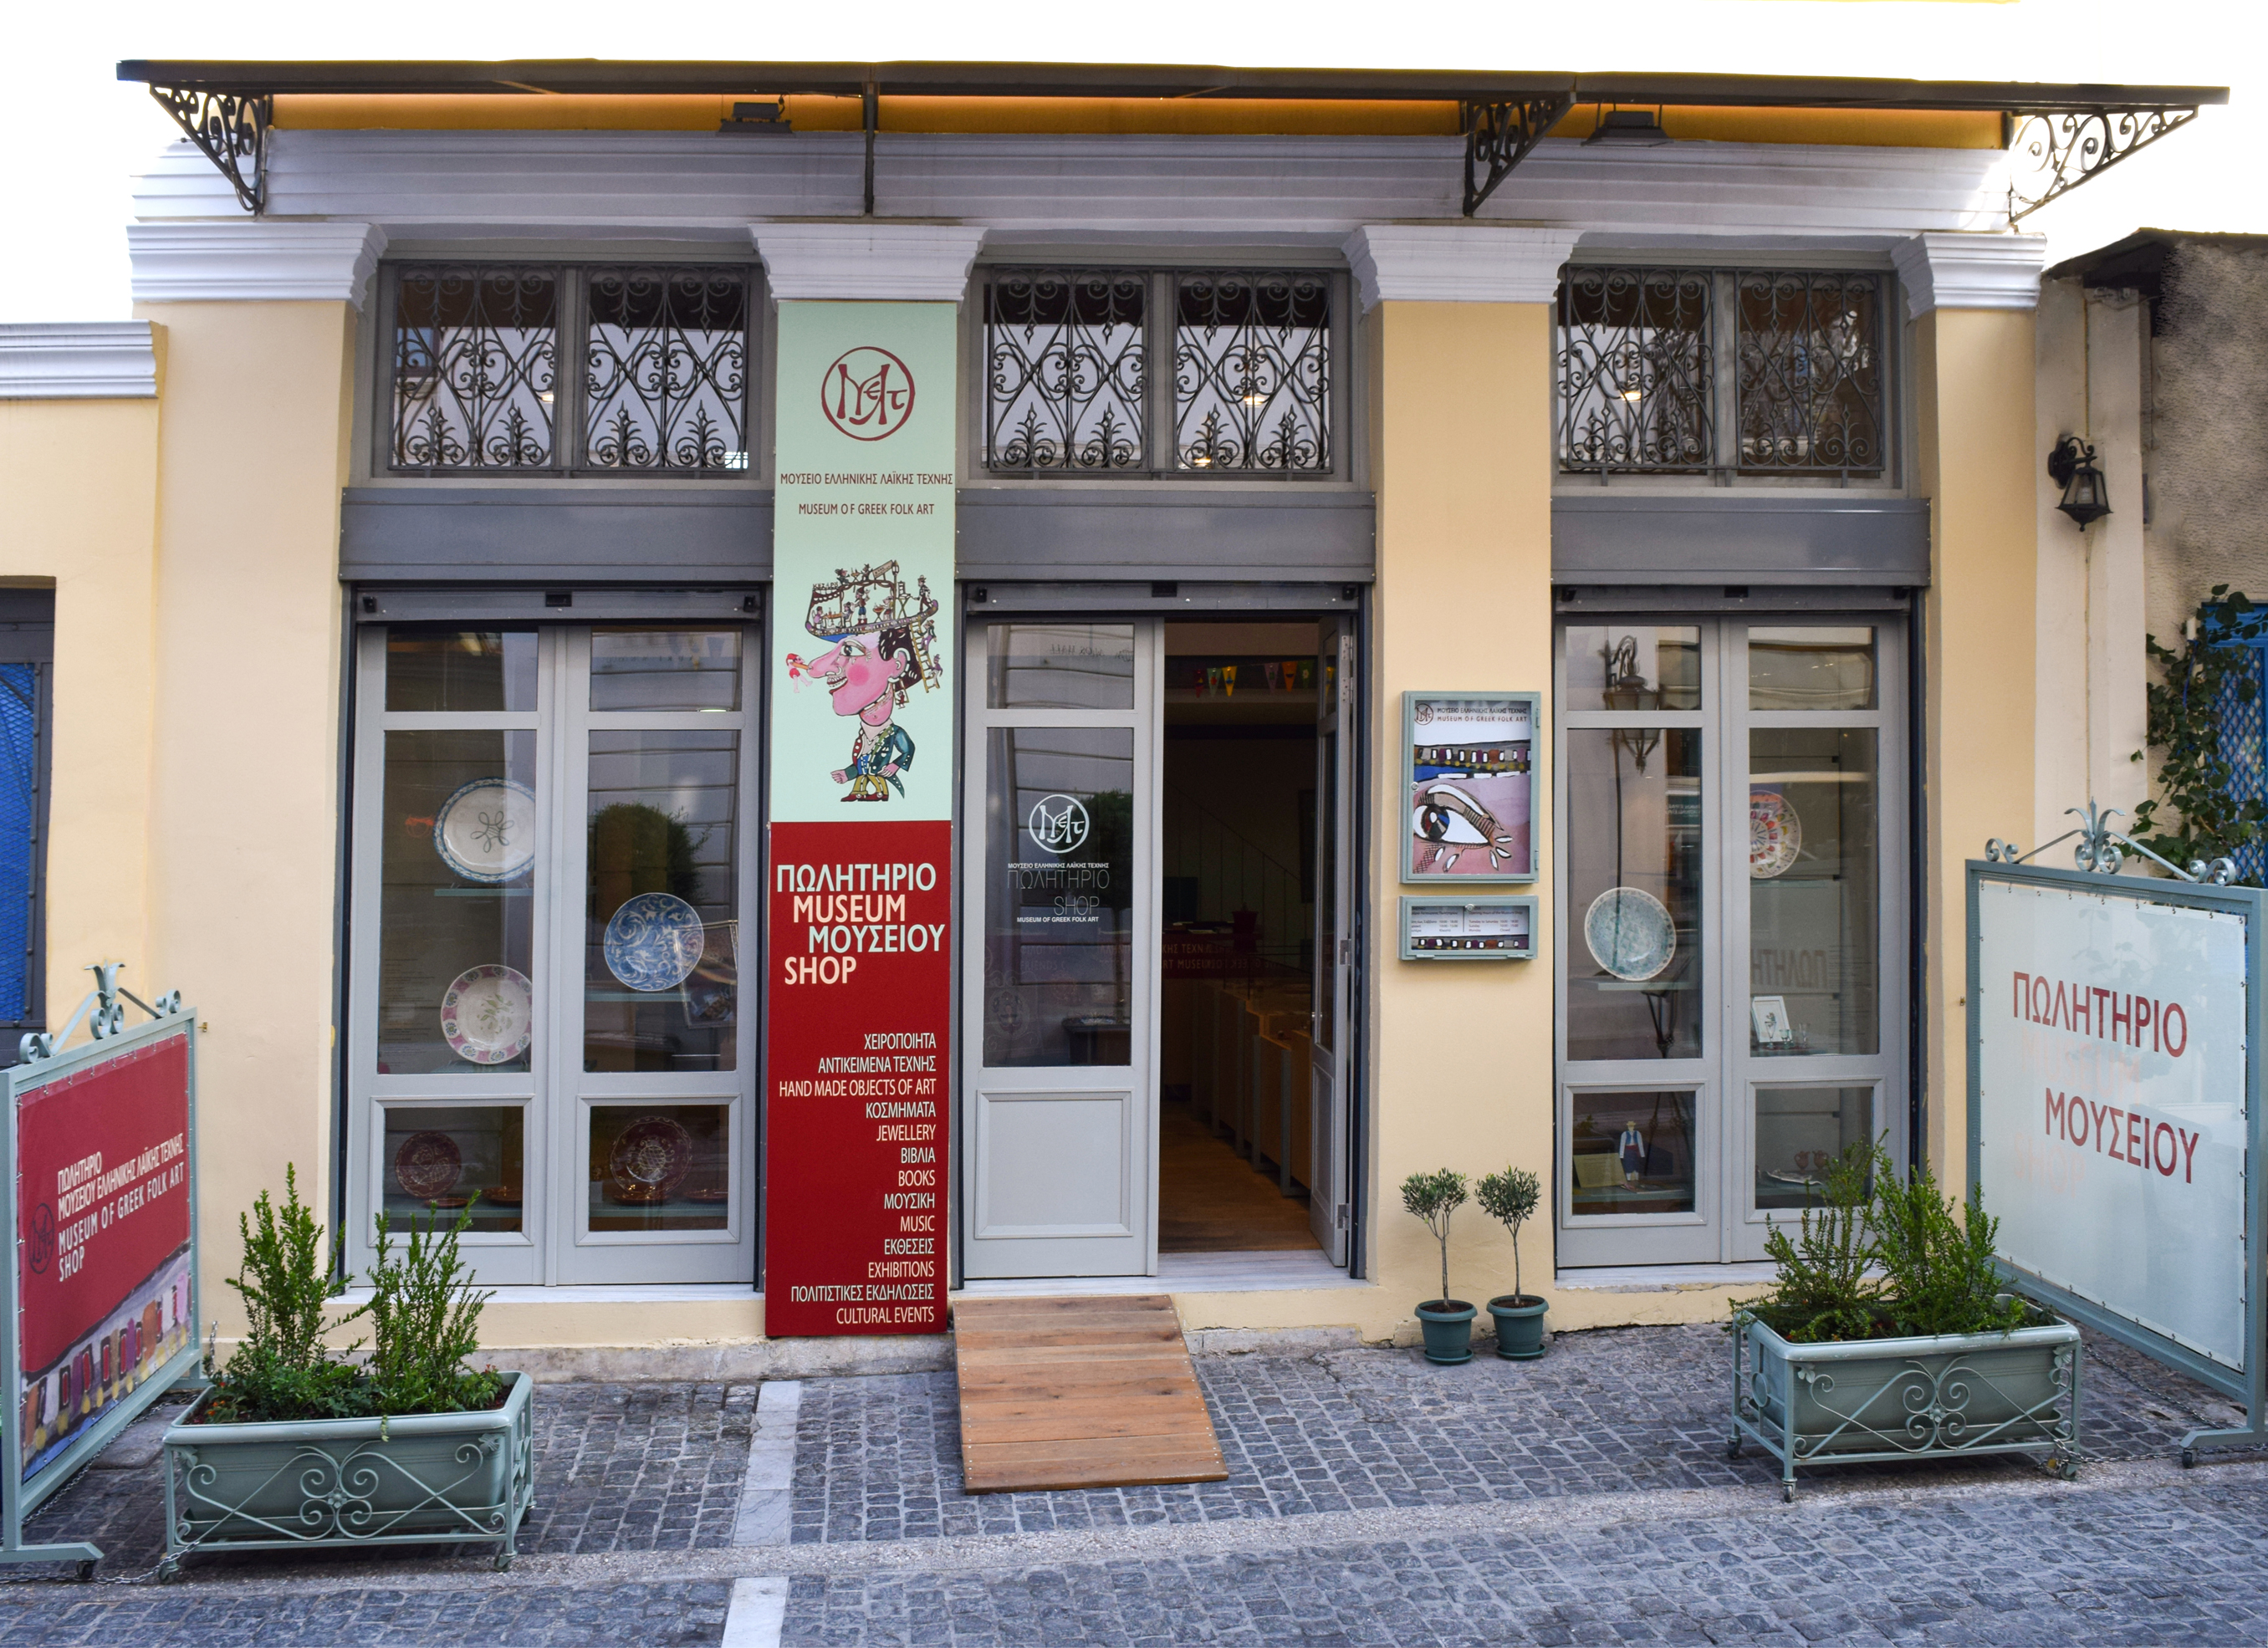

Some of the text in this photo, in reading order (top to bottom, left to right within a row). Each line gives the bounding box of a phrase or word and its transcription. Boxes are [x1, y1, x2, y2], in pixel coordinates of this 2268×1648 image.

[780, 471, 953, 485] ΜΟΥΣΕΙΟ ΕΛΛΗΝΙΚΗΣ ΛΑΪΚΗΣ ΤΕΧΝΗΣ
[799, 503, 935, 515] MUSEUM OF GREEK FOLK ART
[777, 863, 937, 892] ΠΩΛΗΤΗΡΙΟ
[1007, 869, 1110, 889] ΠΩΛΗΤΗΡΙΟ
[794, 894, 905, 923] MUSEUM
[1054, 895, 1100, 916] SHOP
[809, 924, 946, 953] ΜΟΥΣΕΙΟΥ
[784, 957, 856, 985] SHOP
[2013, 971, 2187, 1058] ΠΩΛΗΤΗΡΙΟ
[864, 1033, 936, 1049] ΧΕΙΡΟΠΟΙΗΤΑ
[818, 1055, 936, 1074] ΑΝΤΙΚΕΙΜΕΝΑ ΤΕΧΝΗΣ
[779, 1078, 937, 1097] HAND MADE OBJECTS OF ART
[866, 1101, 936, 1119] ΚΟΣΜΗΜΑΤΑ
[876, 1124, 936, 1141] JEWELLERY
[2046, 1087, 2199, 1184] ΜΟΥΣΕΙΟΥ
[901, 1147, 935, 1164] ΒΙΒΛΙΑ
[58, 1151, 102, 1195] ΠΩΛΗΤΗΡΙΟ
[58, 1180, 96, 1222] ΜΟΥΣΕΙΟΥ
[161, 1133, 183, 1163] ΤΕΧΝΗΣ
[898, 1170, 935, 1186] BOOKS
[59, 1161, 184, 1256] MUSEUM OF GREEK FOLK ART
[884, 1192, 935, 1209] ΜΟΥΣΙΚΗ
[900, 1215, 935, 1232] MUSIC
[884, 1238, 934, 1255] ΕΚΘΕΣΕΙΣ
[59, 1246, 84, 1282] SHOP
[868, 1261, 934, 1278] EXHIBITIONS
[791, 1283, 934, 1302] ΠΟΛΙΤΙΣΤΙΚΕΣ ΕΚΔΗΛΩΣΕΙΣ
[836, 1306, 934, 1324] CULTURAL EVENTS
